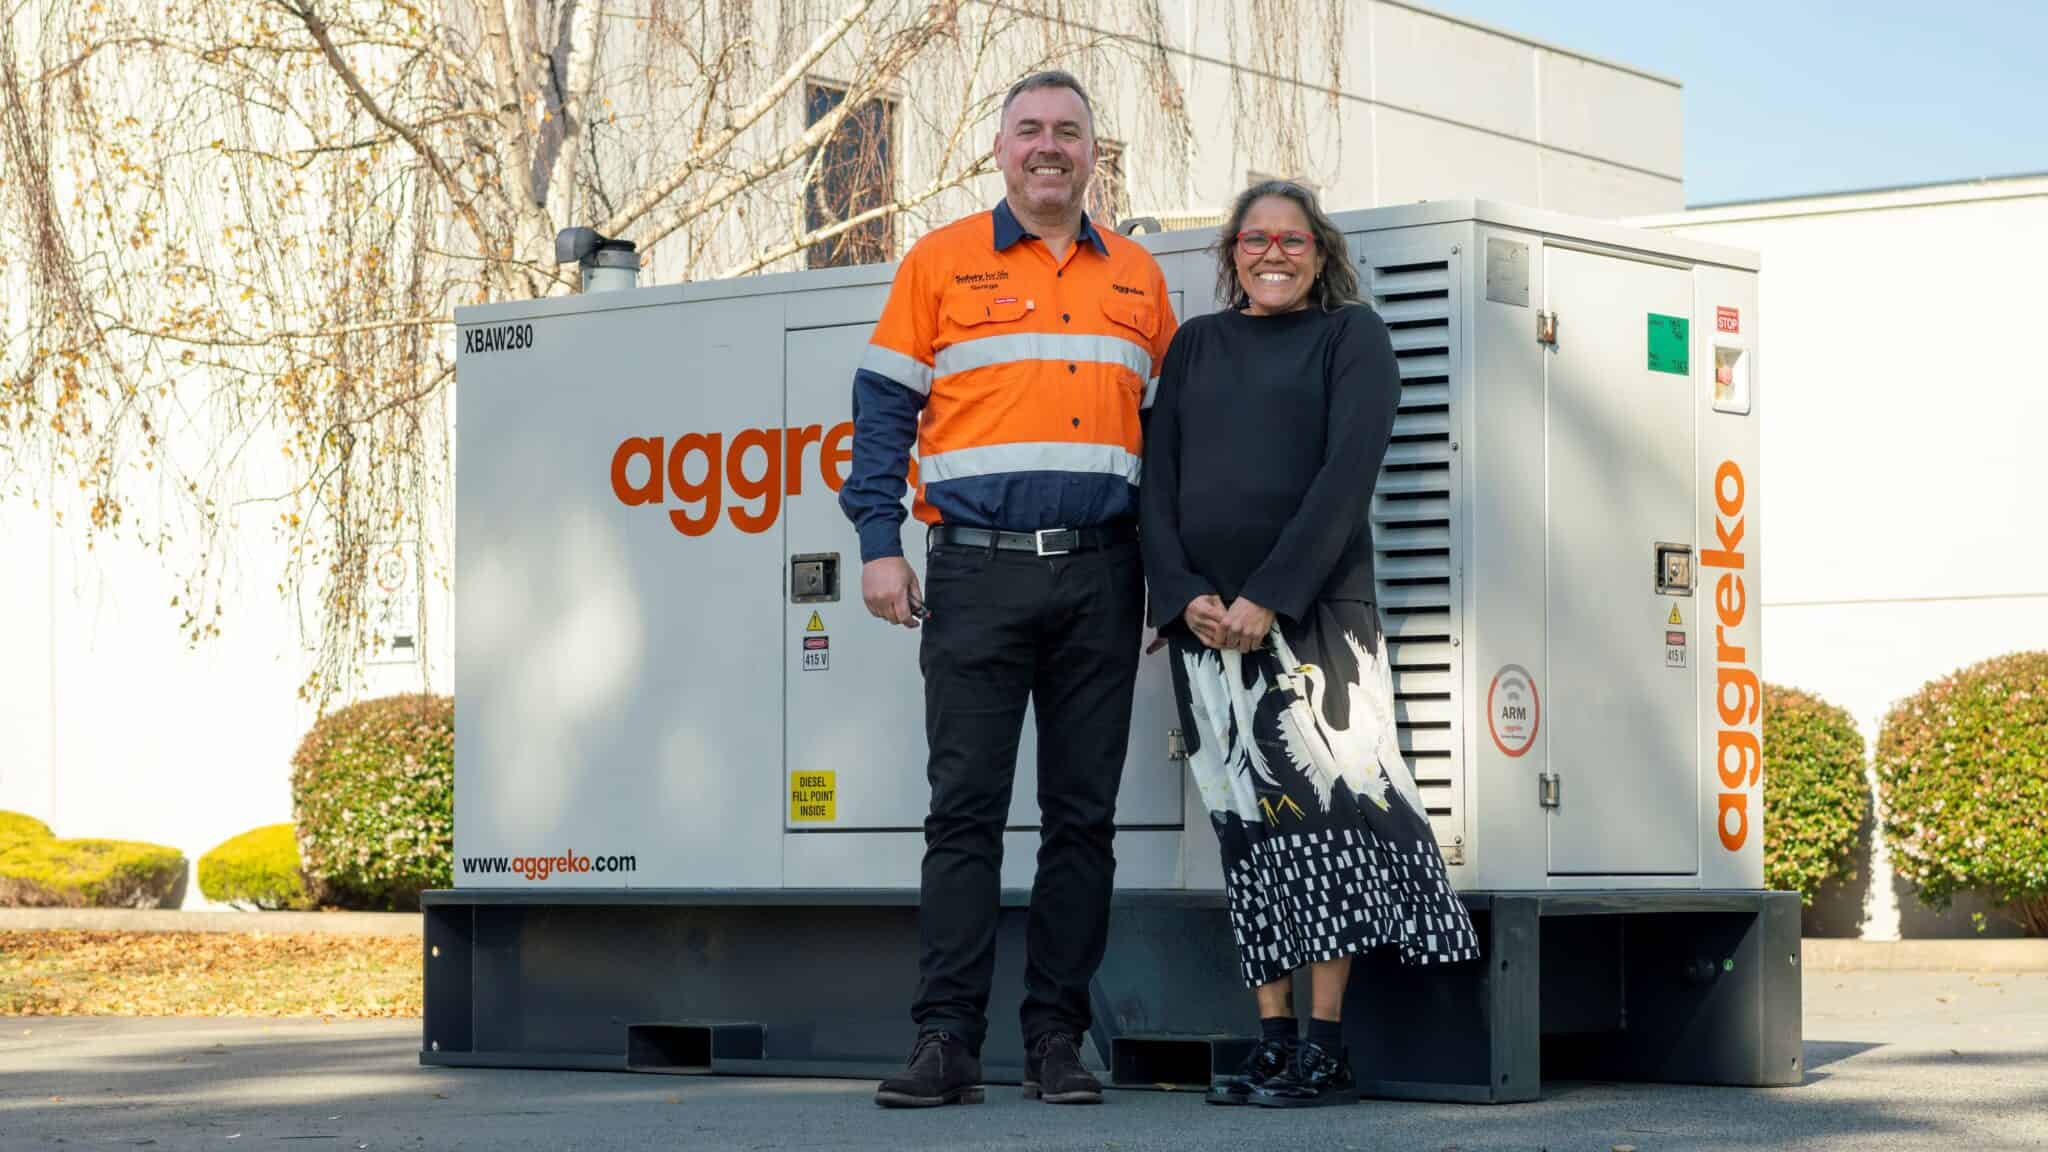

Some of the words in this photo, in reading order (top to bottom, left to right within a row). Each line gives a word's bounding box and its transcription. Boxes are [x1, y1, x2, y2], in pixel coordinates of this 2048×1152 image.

[1718, 317, 1737, 330] STOP
[465, 323, 533, 354] XBAW280
[611, 421, 918, 537] aggre
[805, 653, 819, 665] 415
[820, 653, 827, 665] V
[1700, 460, 1761, 851] aggreko
[1502, 706, 1527, 720] ARM
[799, 776, 826, 787] DIESEL
[792, 791, 808, 802] FILL
[811, 790, 833, 802] POINT
[800, 805, 826, 816] INSIDE
[462, 848, 637, 880] www.aggreko.com
